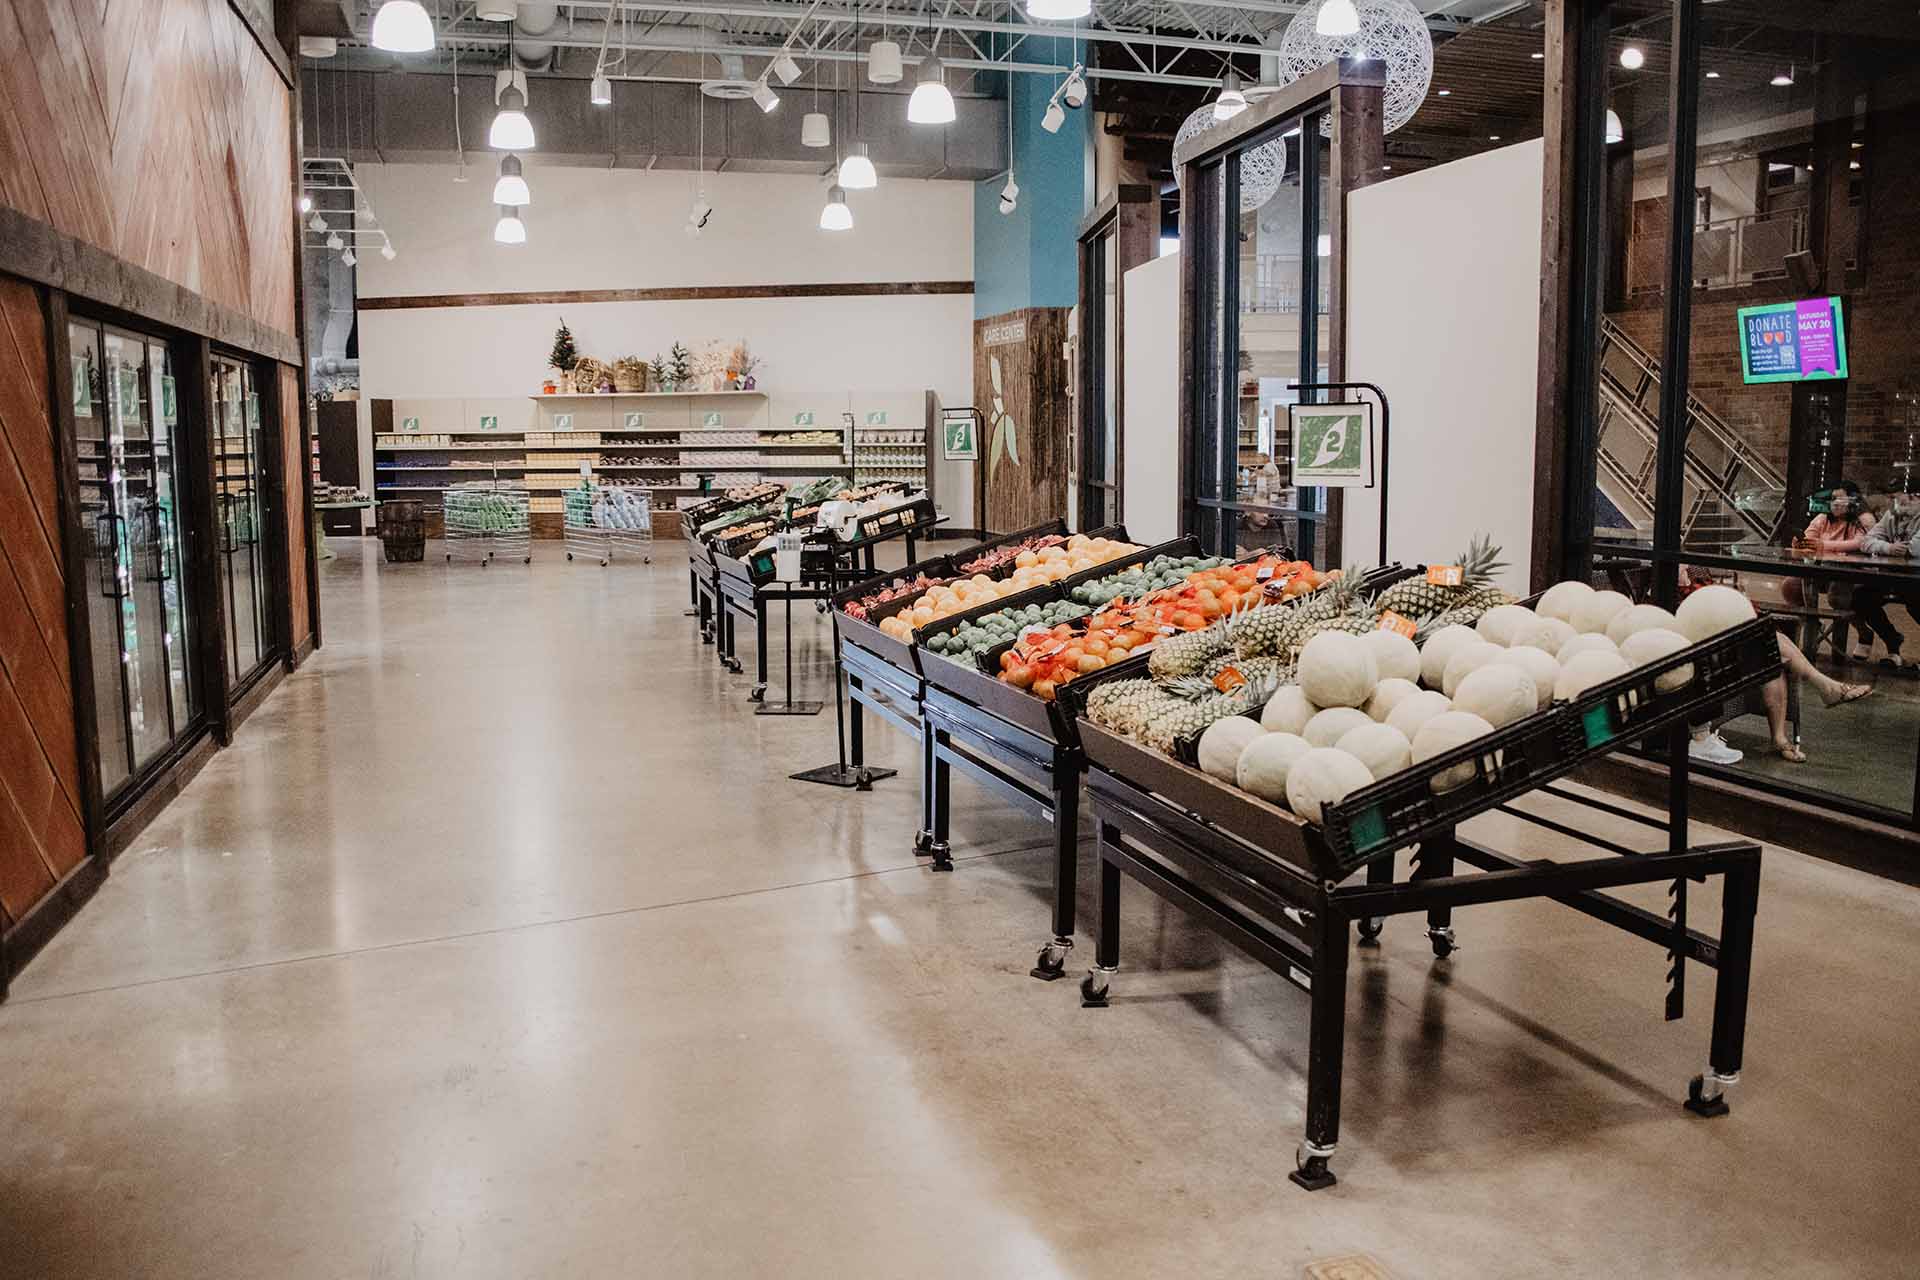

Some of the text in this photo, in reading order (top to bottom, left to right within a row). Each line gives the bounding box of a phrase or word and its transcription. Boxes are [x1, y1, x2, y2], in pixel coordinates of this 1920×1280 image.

[1799, 312, 1828, 320] SATURDAY
[1749, 315, 1792, 332] DONATE
[1798, 319, 1831, 331] MAY 20
[957, 431, 963, 442] 2
[1327, 431, 1340, 452] 2
